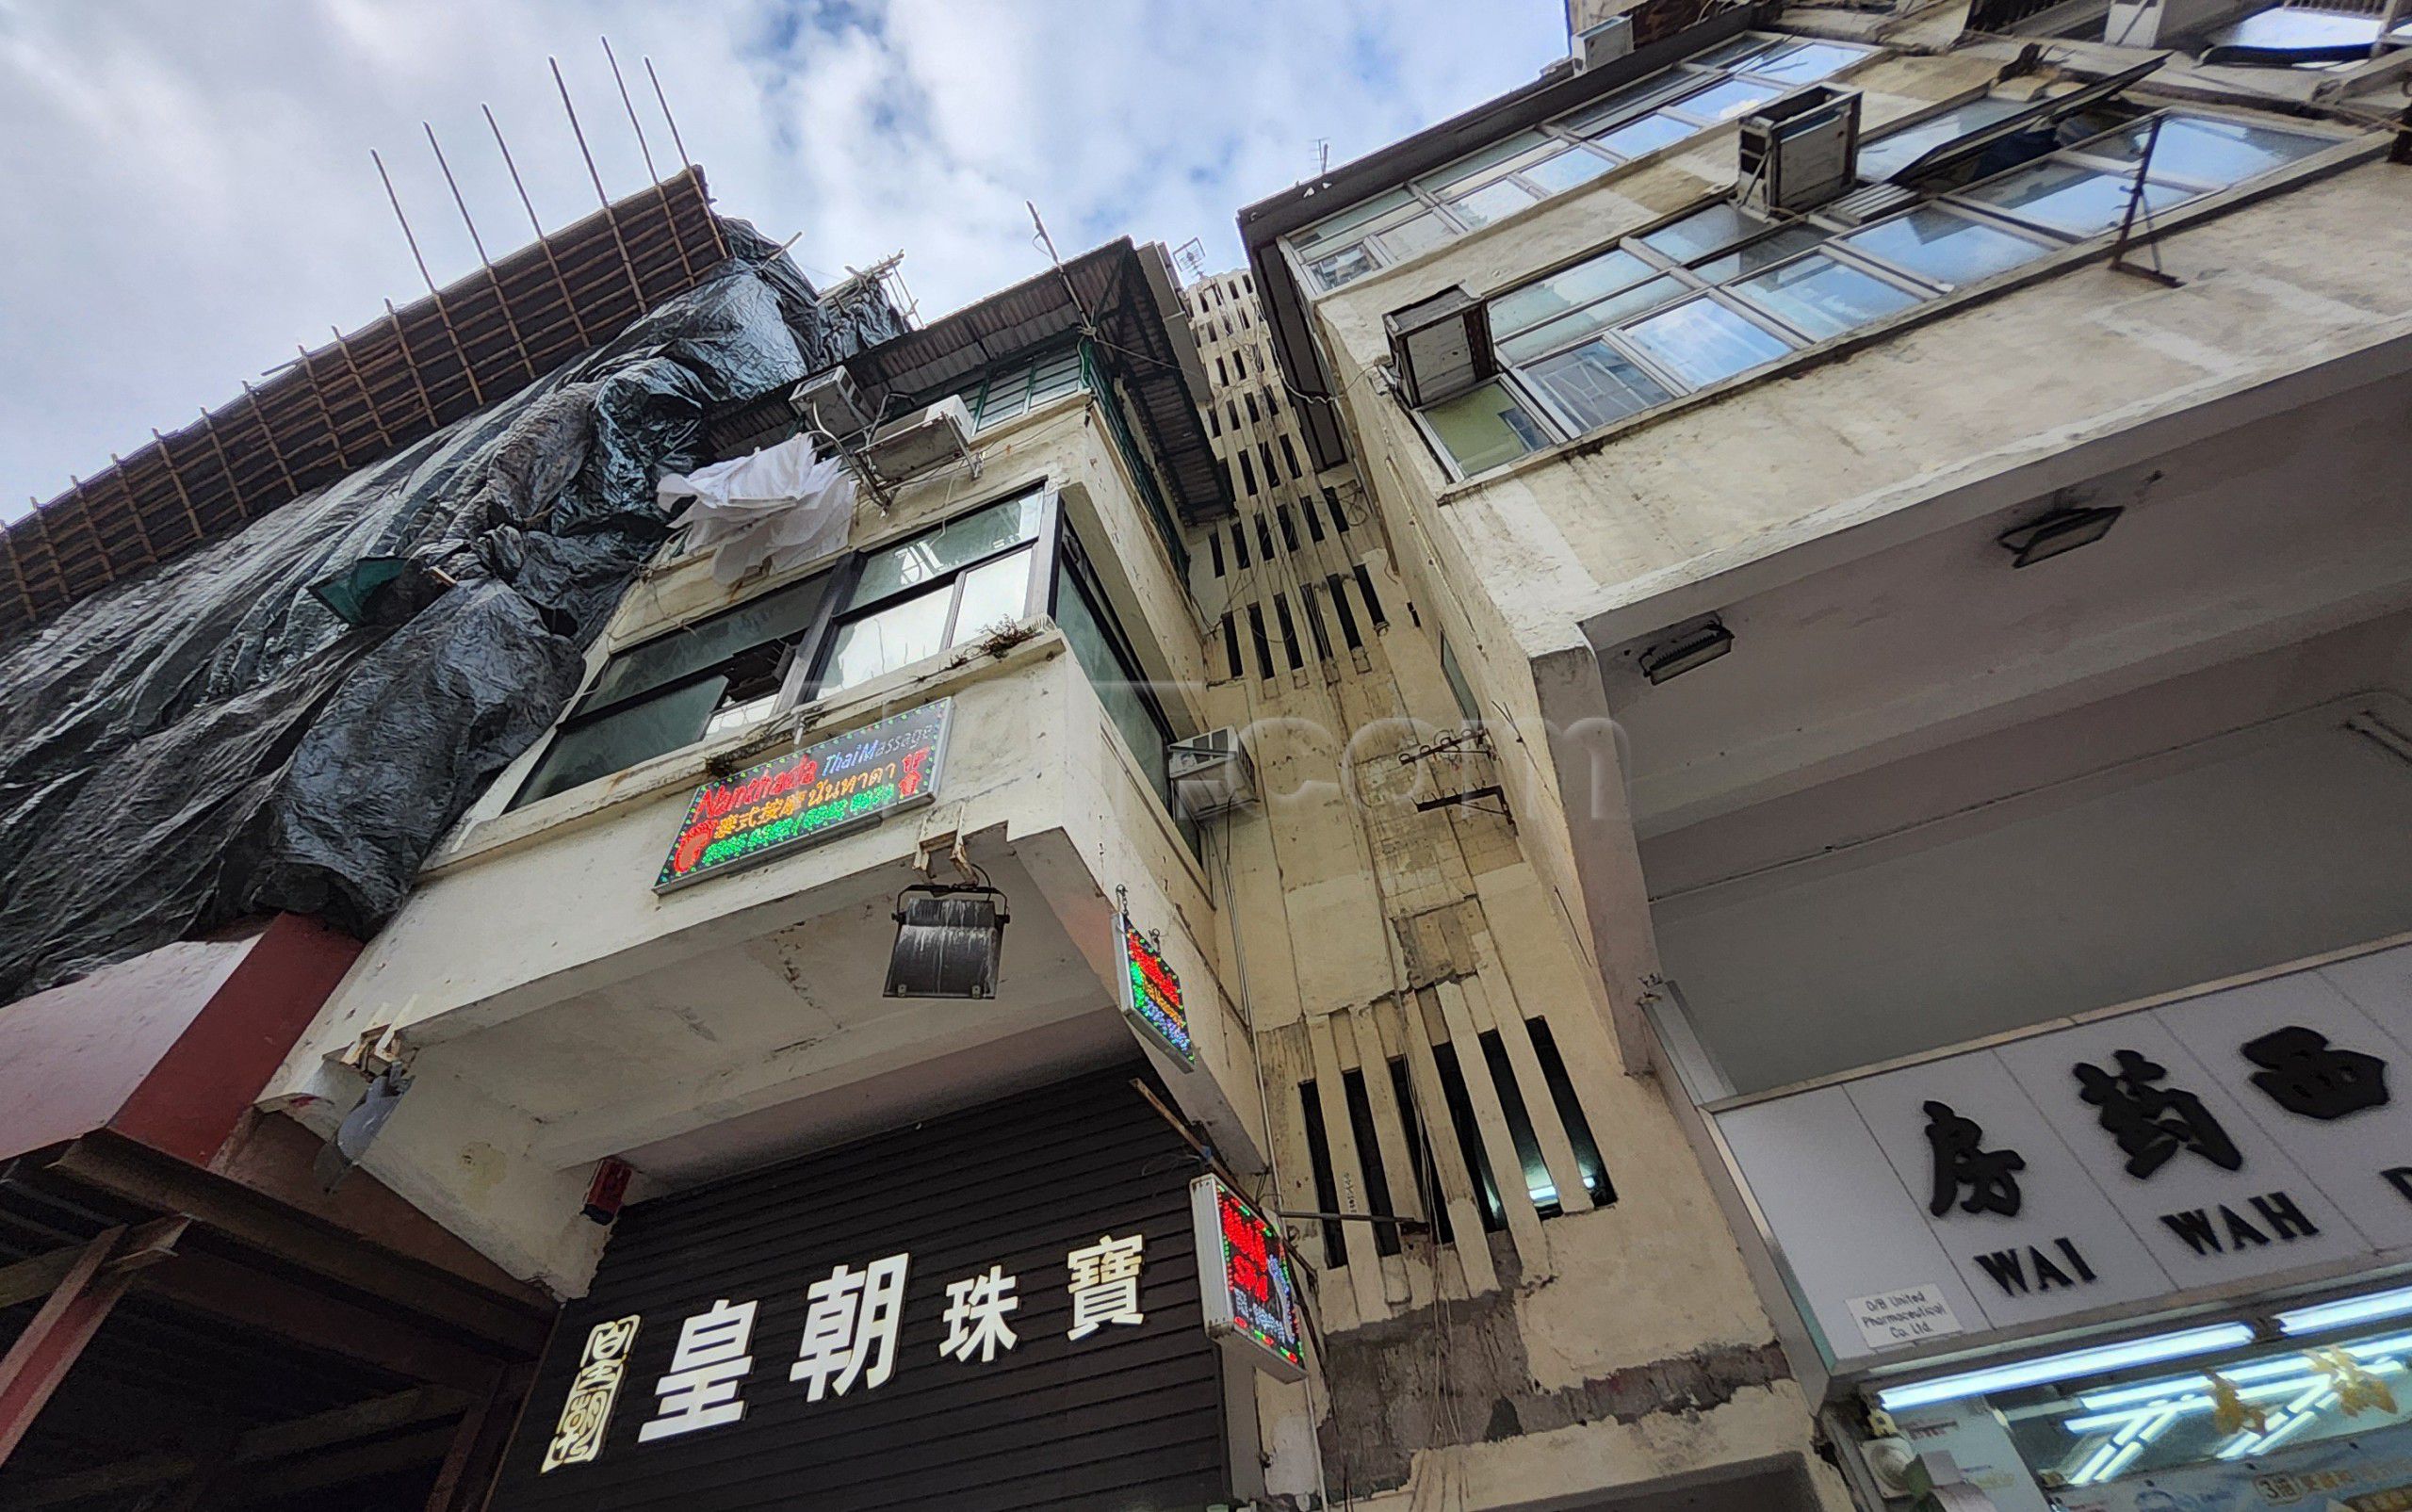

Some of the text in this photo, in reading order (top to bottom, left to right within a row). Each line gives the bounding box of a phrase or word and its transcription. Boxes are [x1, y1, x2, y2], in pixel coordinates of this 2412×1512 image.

[1974, 1191, 2320, 1296] WAI WAH
[638, 1233, 1145, 1443] 皇朝珠寶
